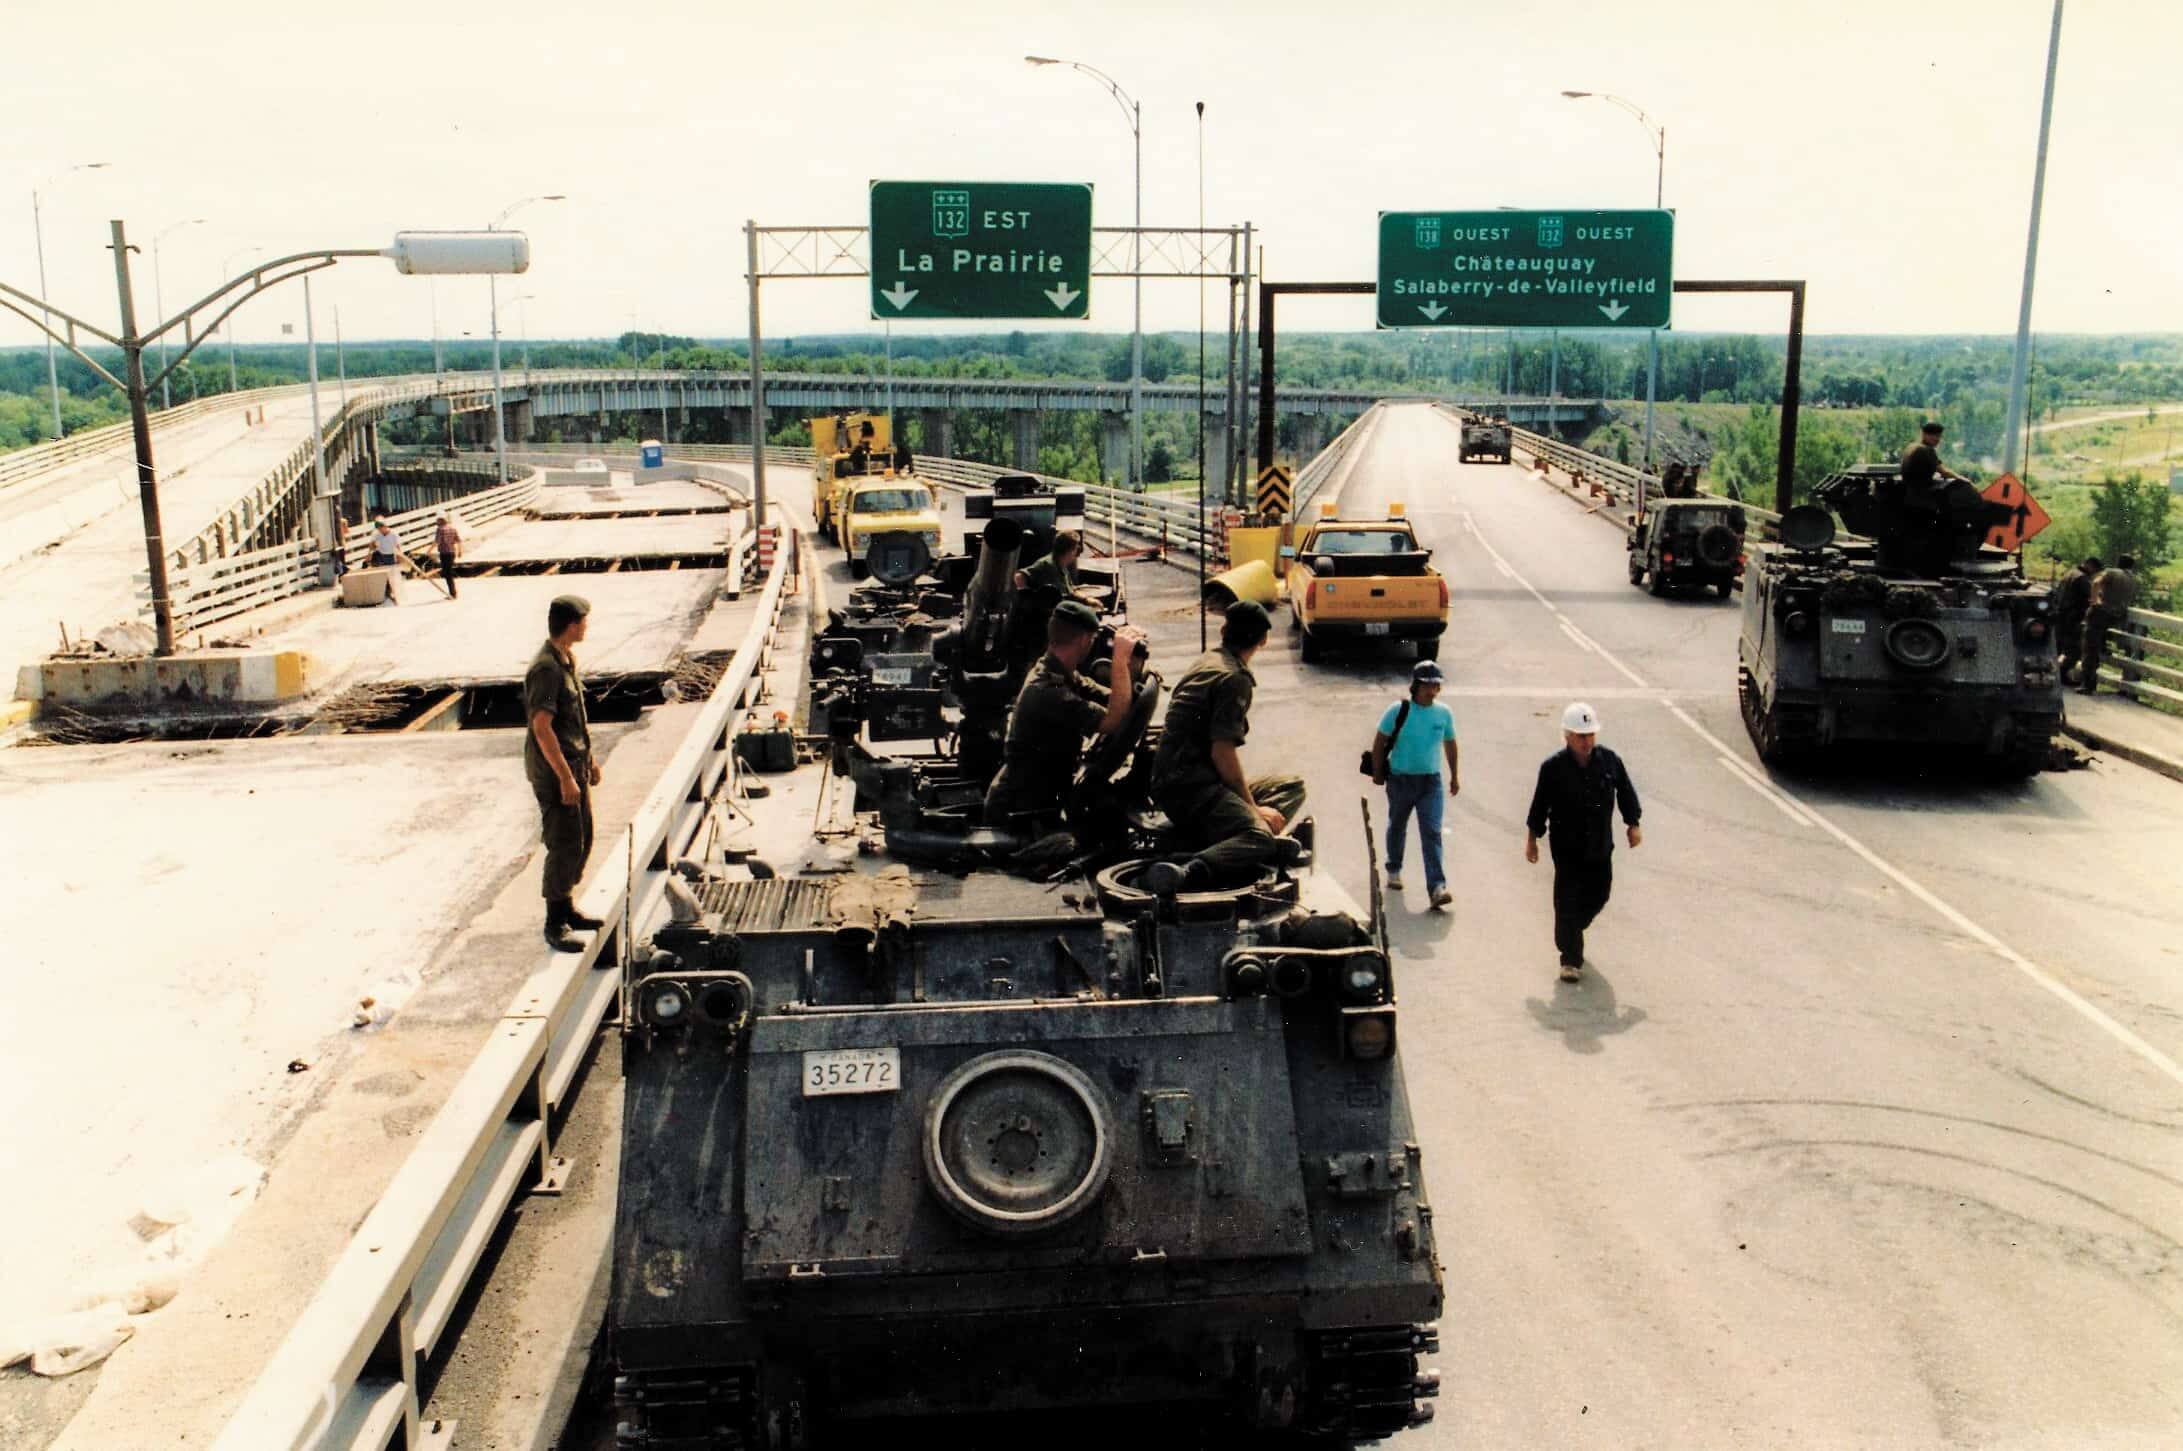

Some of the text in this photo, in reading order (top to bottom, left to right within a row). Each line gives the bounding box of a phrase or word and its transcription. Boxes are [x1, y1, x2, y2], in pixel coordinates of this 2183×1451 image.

[937, 210, 1031, 229] 132 EST
[1418, 227, 1634, 243] 138 OUEST 132 OUEST
[899, 248, 1064, 272] La Prairie
[1454, 255, 1596, 274] Châteauguay
[1394, 278, 1656, 297] Salaberry-de-Valleyfield
[811, 1062, 891, 1086] 35272
